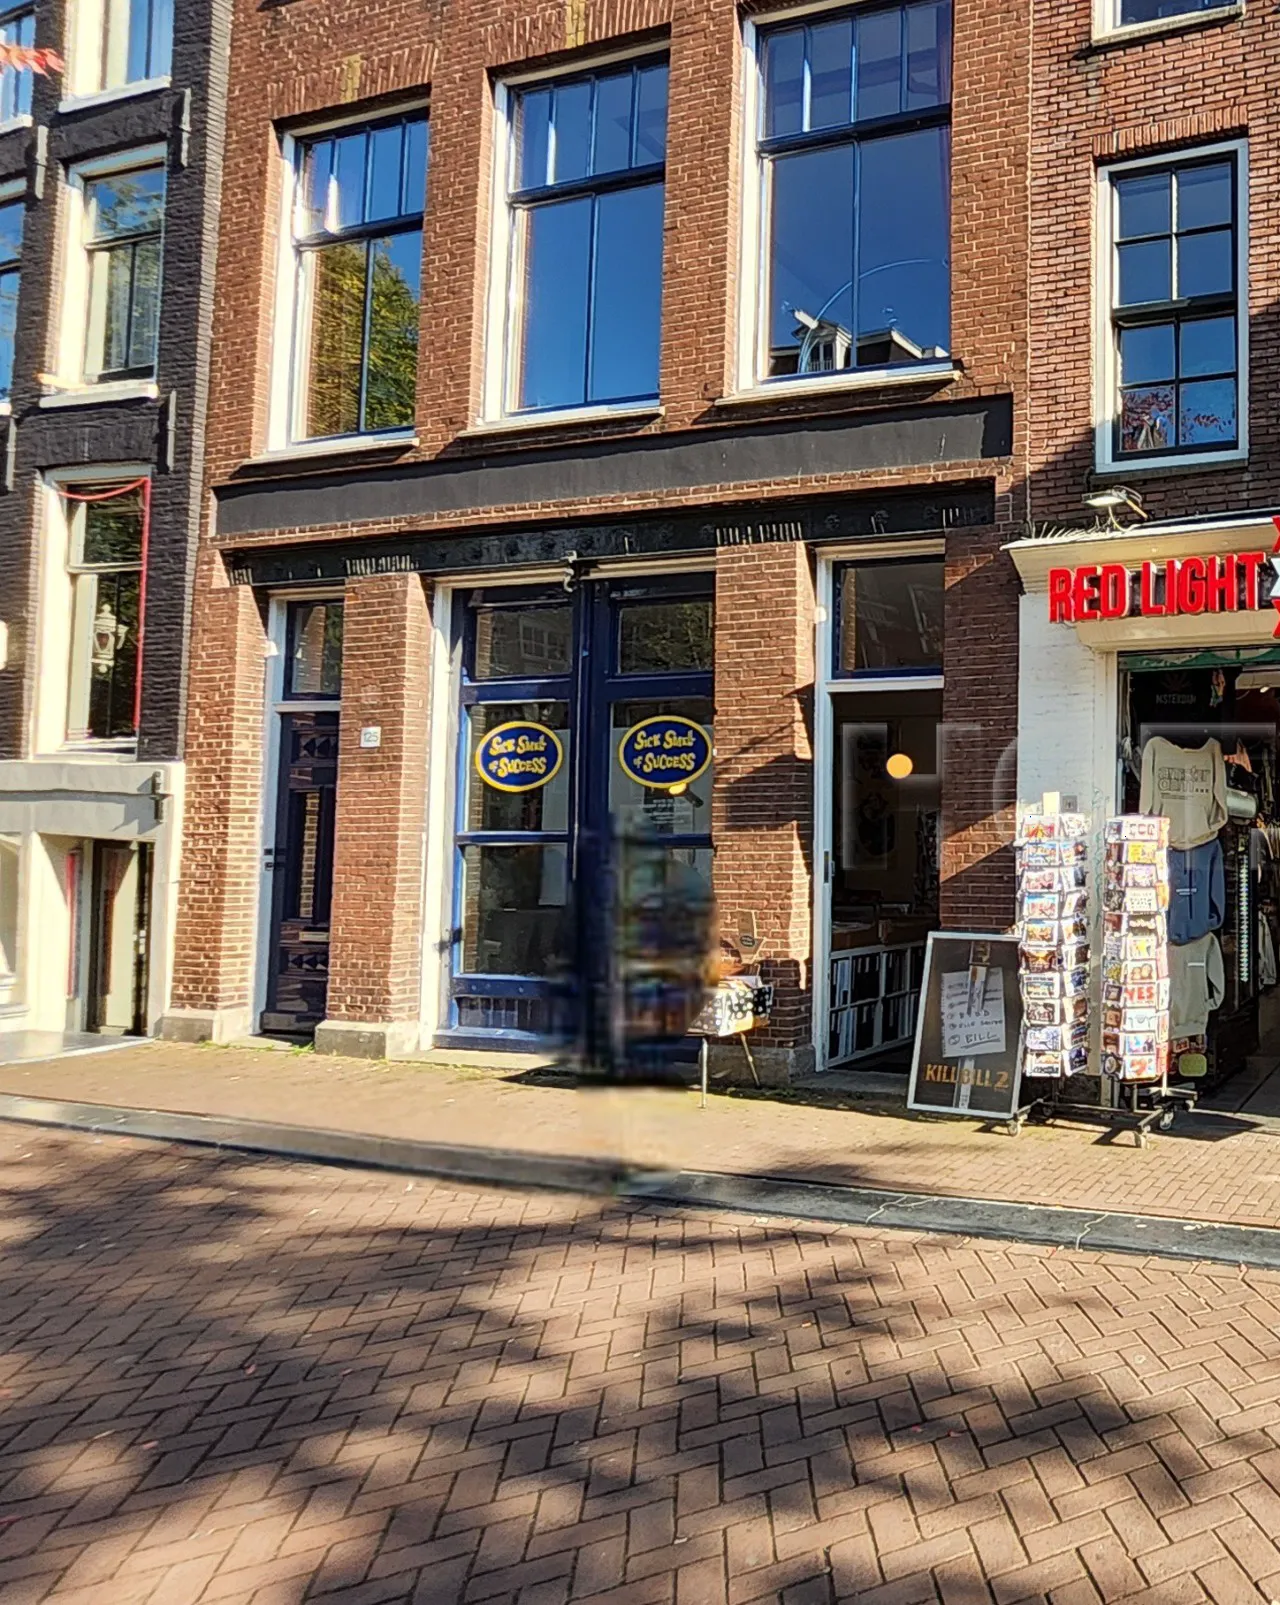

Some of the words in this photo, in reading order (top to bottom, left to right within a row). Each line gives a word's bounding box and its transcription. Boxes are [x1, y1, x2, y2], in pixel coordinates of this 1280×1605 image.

[1049, 564, 1130, 623] RED
[1140, 551, 1268, 616] LIGHT
[1125, 986, 1155, 1002] YES
[925, 1063, 957, 1083] KILL
[960, 1067, 992, 1087] BILL
[994, 1071, 1009, 1088] 2
